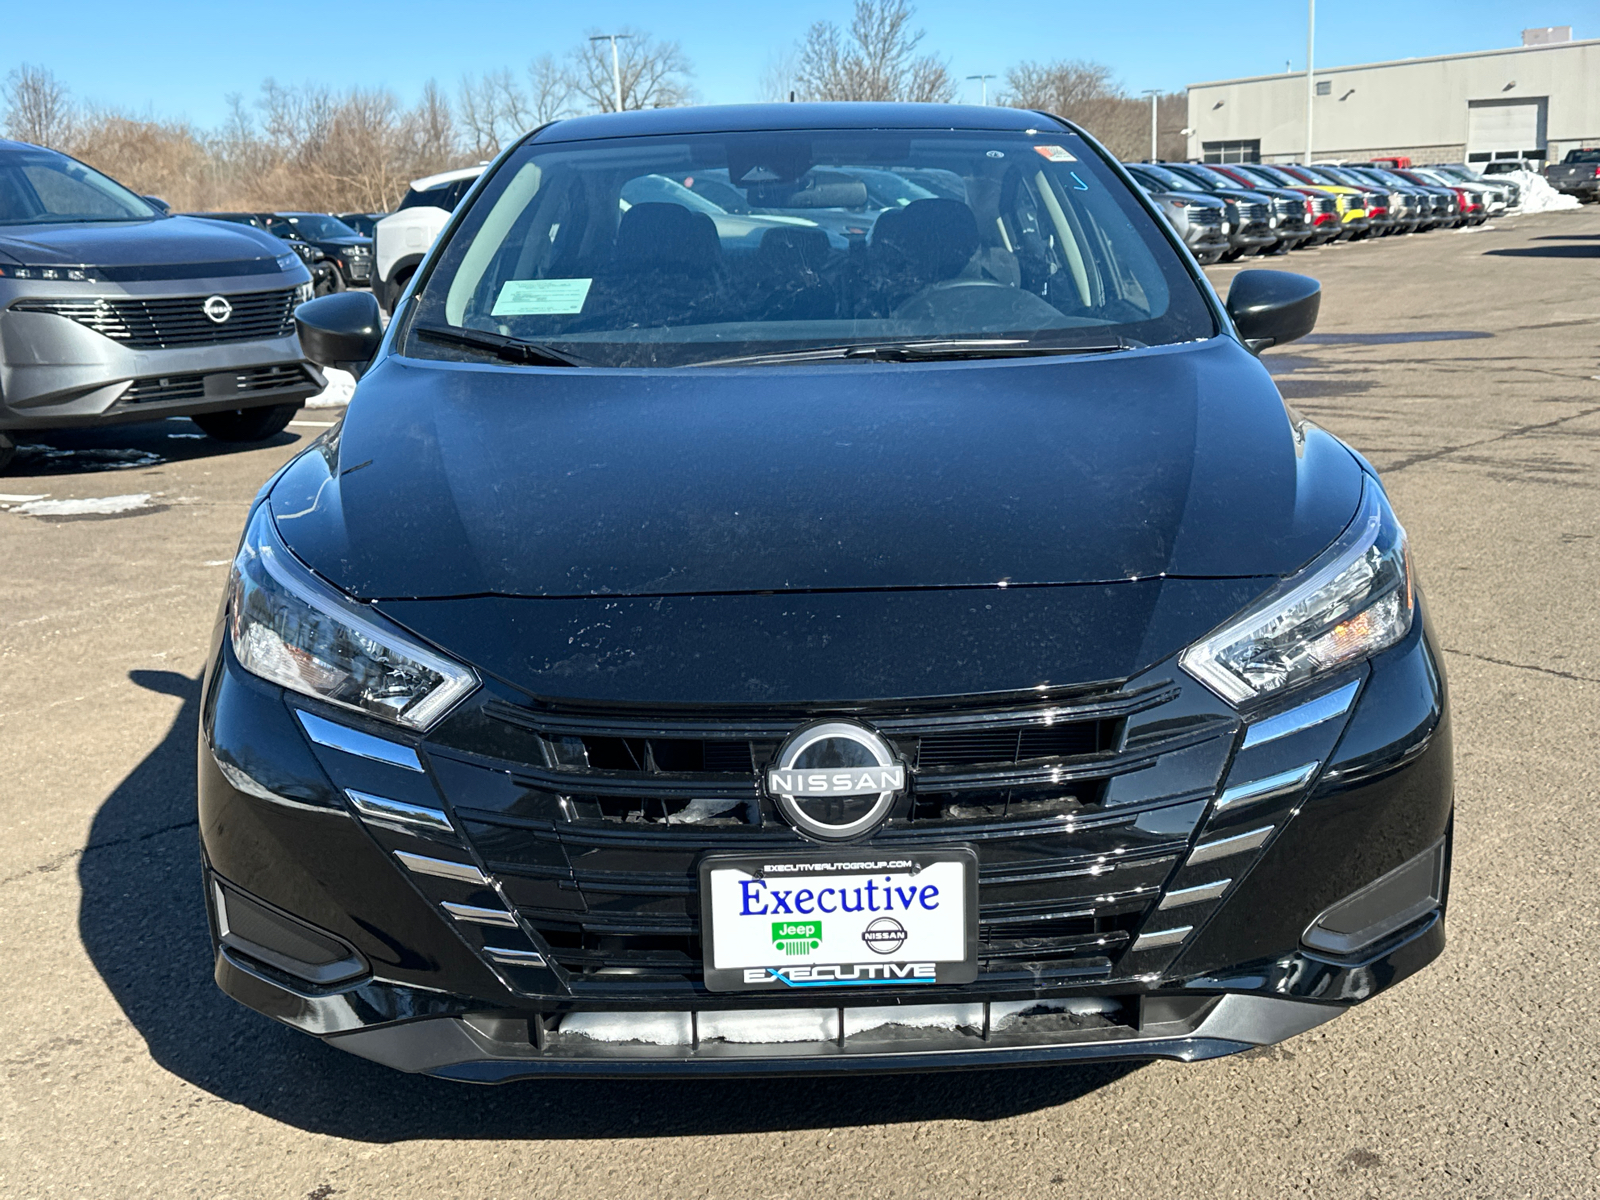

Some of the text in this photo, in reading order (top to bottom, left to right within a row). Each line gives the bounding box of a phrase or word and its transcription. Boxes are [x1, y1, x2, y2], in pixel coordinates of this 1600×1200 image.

[771, 770, 901, 791] NISSAN
[763, 860, 912, 872] EXECUTIVEAUTOGROUP.COM
[738, 876, 940, 916] Executive
[779, 924, 815, 936] Jeep
[864, 931, 905, 940] NISSAN
[743, 963, 936, 986] EXECUTIVE
